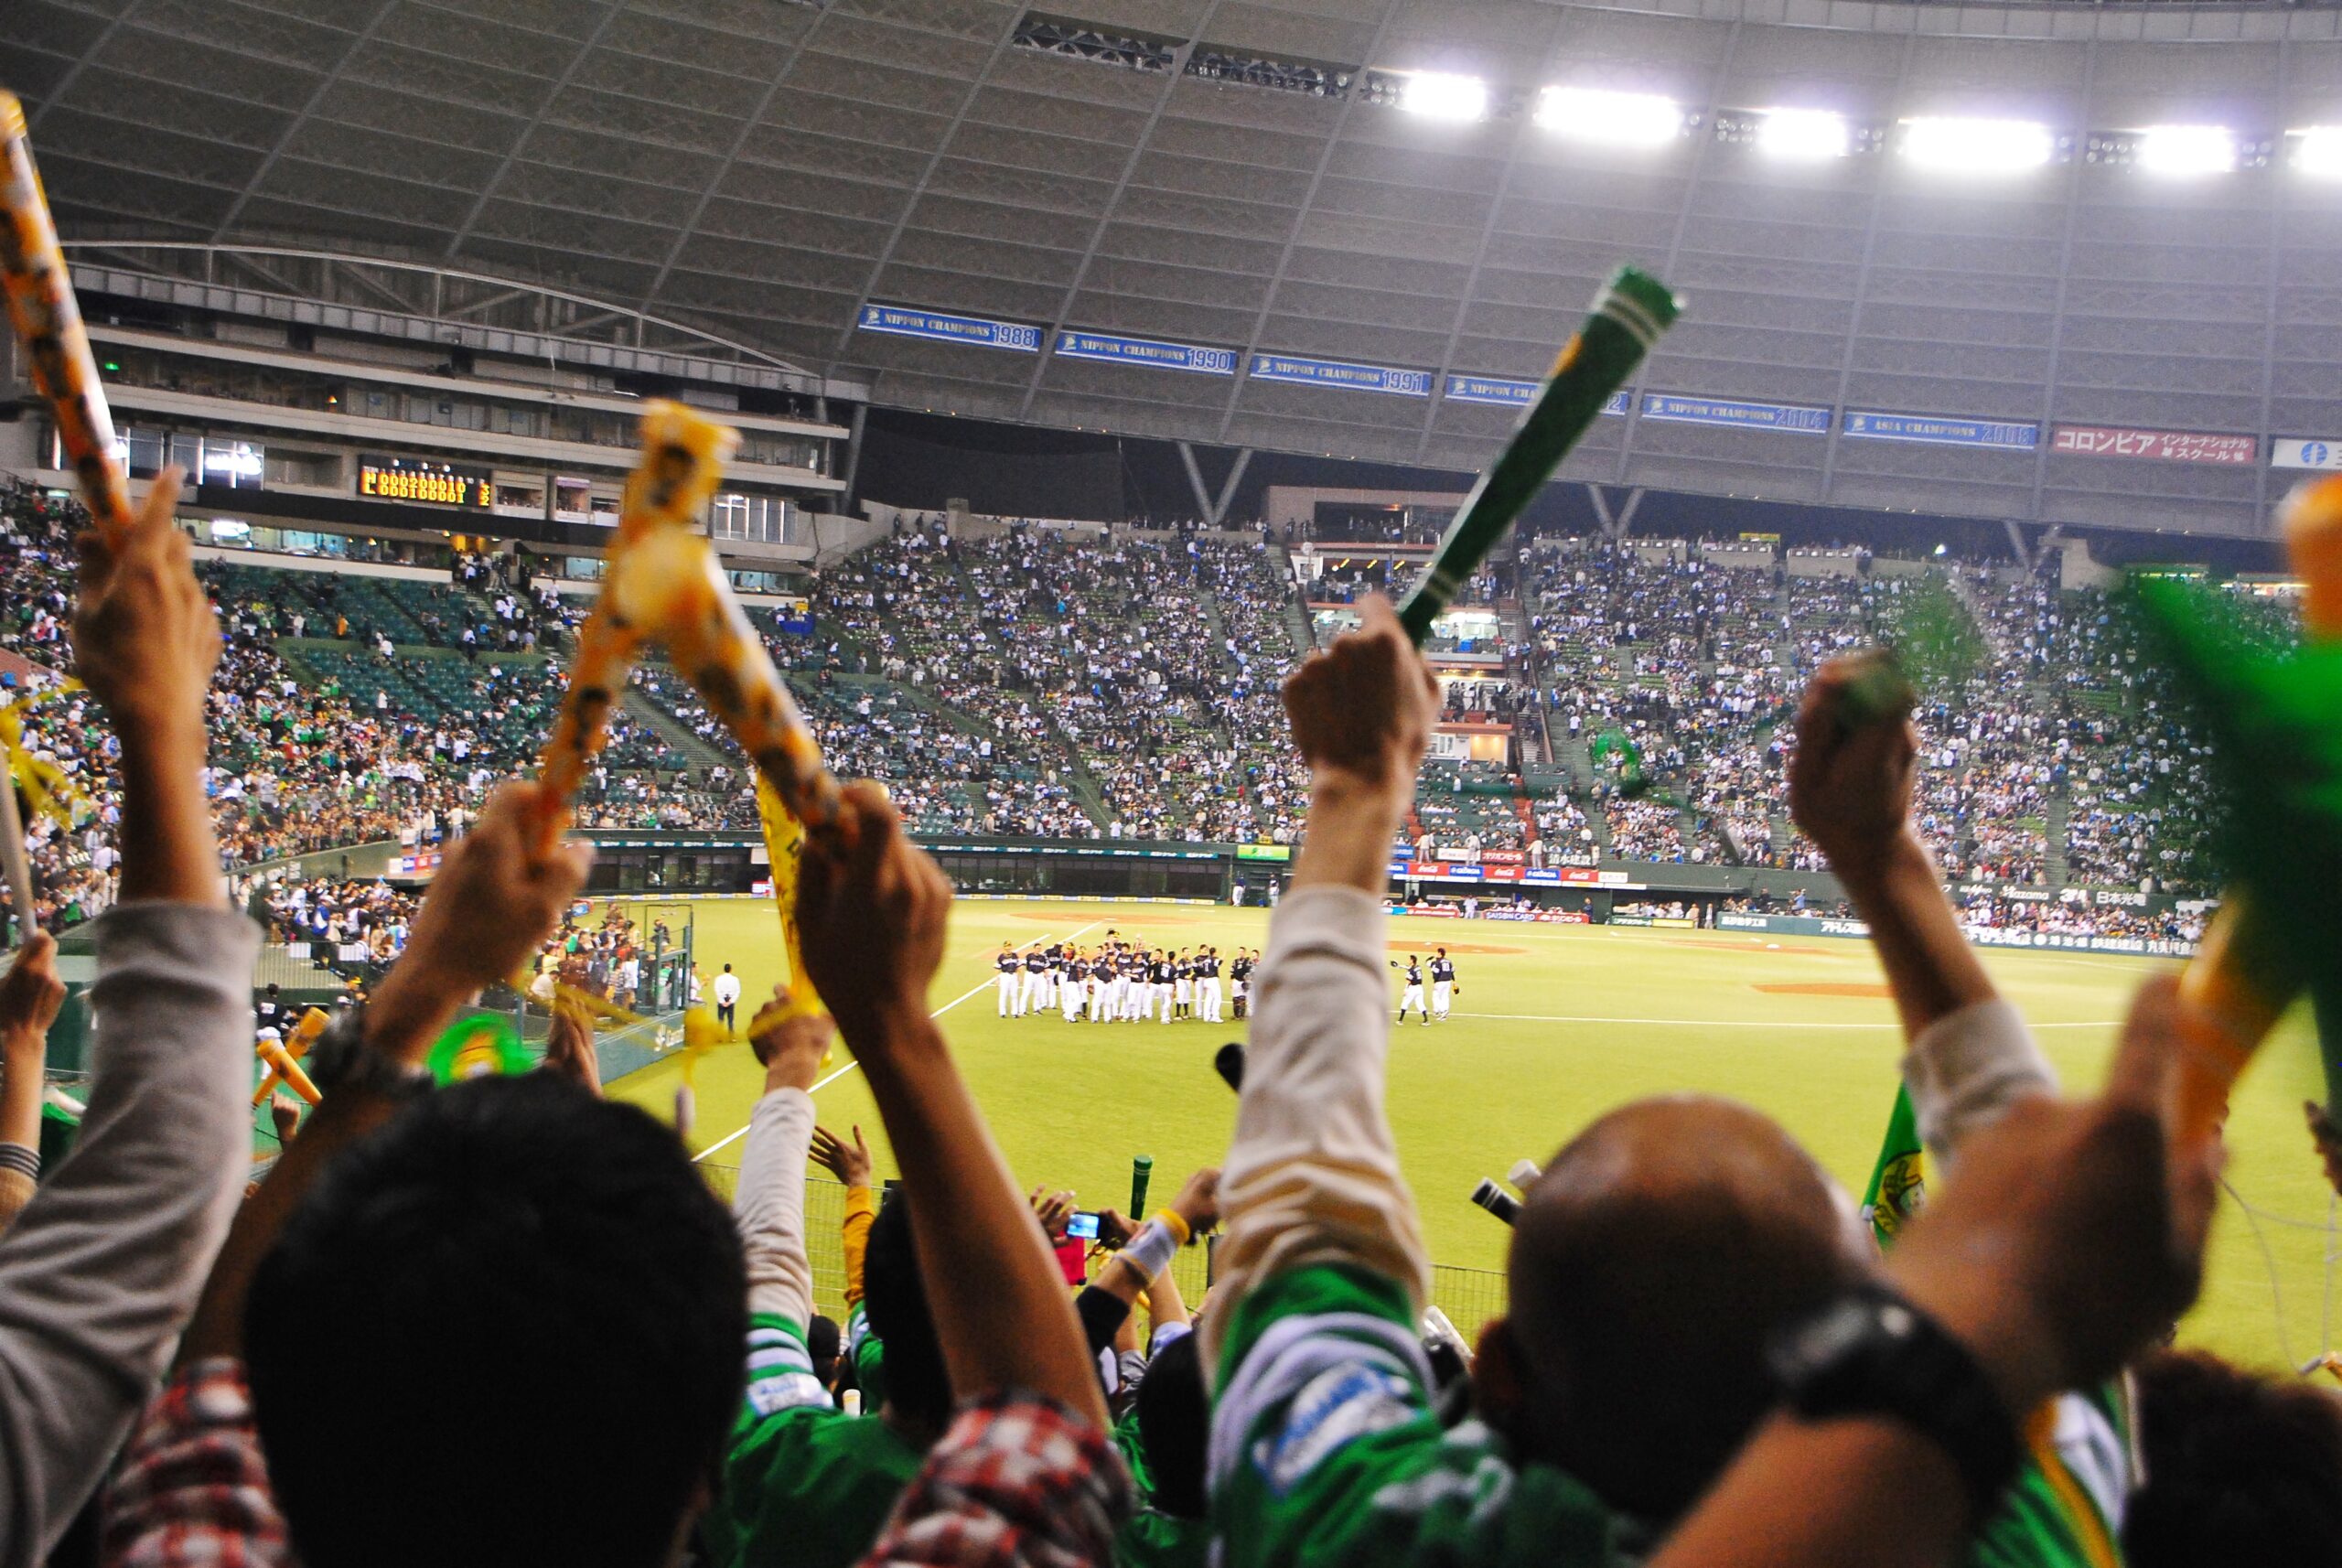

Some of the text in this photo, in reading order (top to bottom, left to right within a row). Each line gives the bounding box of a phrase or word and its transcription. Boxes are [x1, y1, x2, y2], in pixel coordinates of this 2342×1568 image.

[885, 313, 1035, 348] NIPPON CHAMPIONS 1988
[1080, 339, 1230, 371] NIPPON CHAMPIONS 1990
[1275, 361, 1423, 392] NIPPON CHAMPIONS 1991
[1470, 382, 1510, 396] NIPPON
[1668, 402, 1822, 429] NIPPON CHAMPIONS 2004
[1875, 420, 1902, 431] ASIA
[1906, 423, 1976, 437] CHAMPIONS
[2057, 431, 2156, 454] コロンビア
[2160, 434, 2250, 450] インターナショナル
[2176, 448, 2229, 461] スクール
[2002, 885, 2049, 900] Hazama
[2096, 891, 2147, 907] 日本光電
[1515, 913, 1536, 921] CARD
